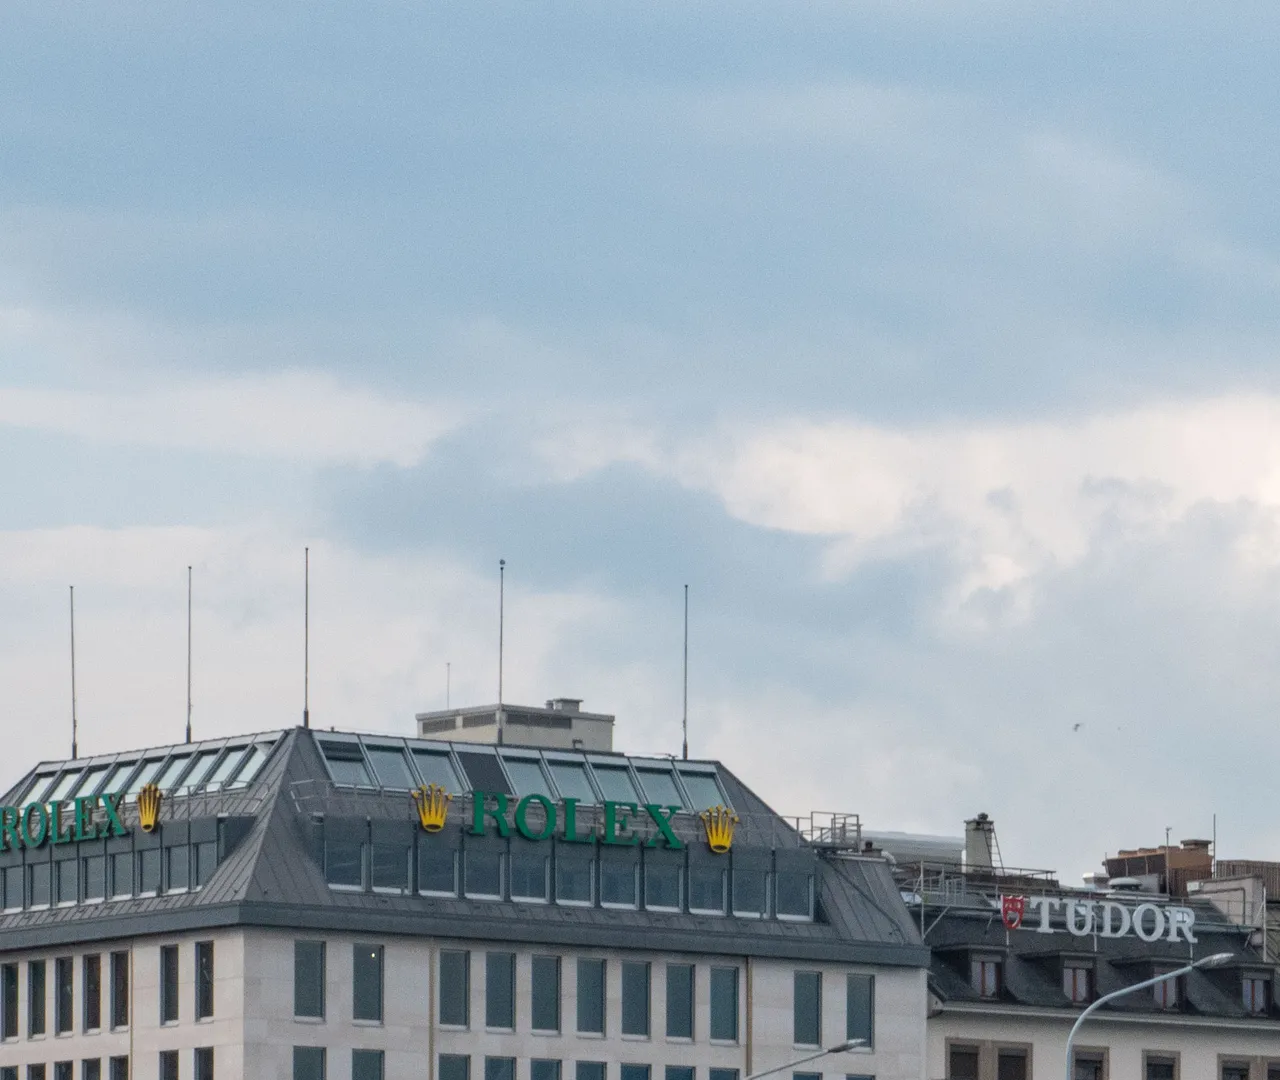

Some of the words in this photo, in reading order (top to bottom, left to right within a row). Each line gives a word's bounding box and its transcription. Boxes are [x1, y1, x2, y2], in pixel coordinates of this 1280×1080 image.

[0, 788, 126, 850] ROLEX
[469, 791, 685, 849] ROLEX
[1030, 896, 1198, 943] TUDOR
